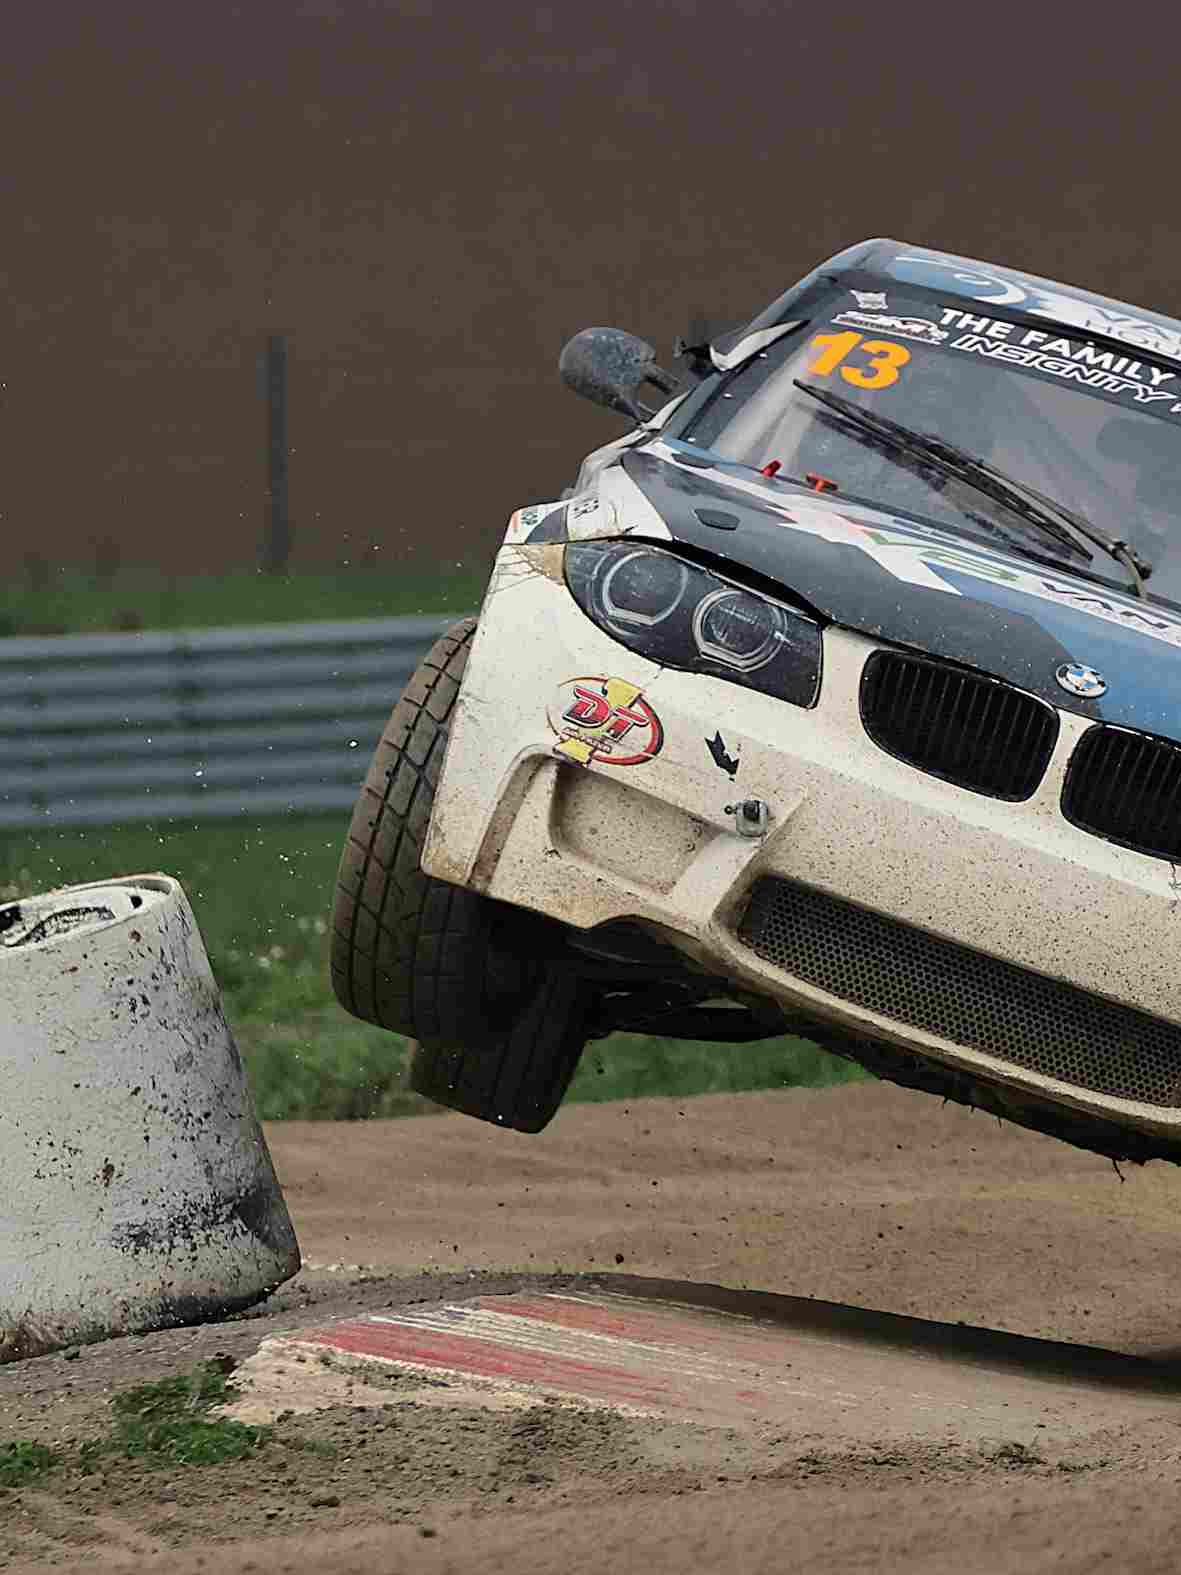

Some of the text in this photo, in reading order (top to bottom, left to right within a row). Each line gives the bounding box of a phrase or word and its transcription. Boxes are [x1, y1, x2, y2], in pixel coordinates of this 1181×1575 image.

[804, 330, 911, 390] 13
[940, 307, 1014, 338] THE
[1021, 331, 1175, 386] FAMILY
[950, 334, 1177, 403] INSIGNITY
